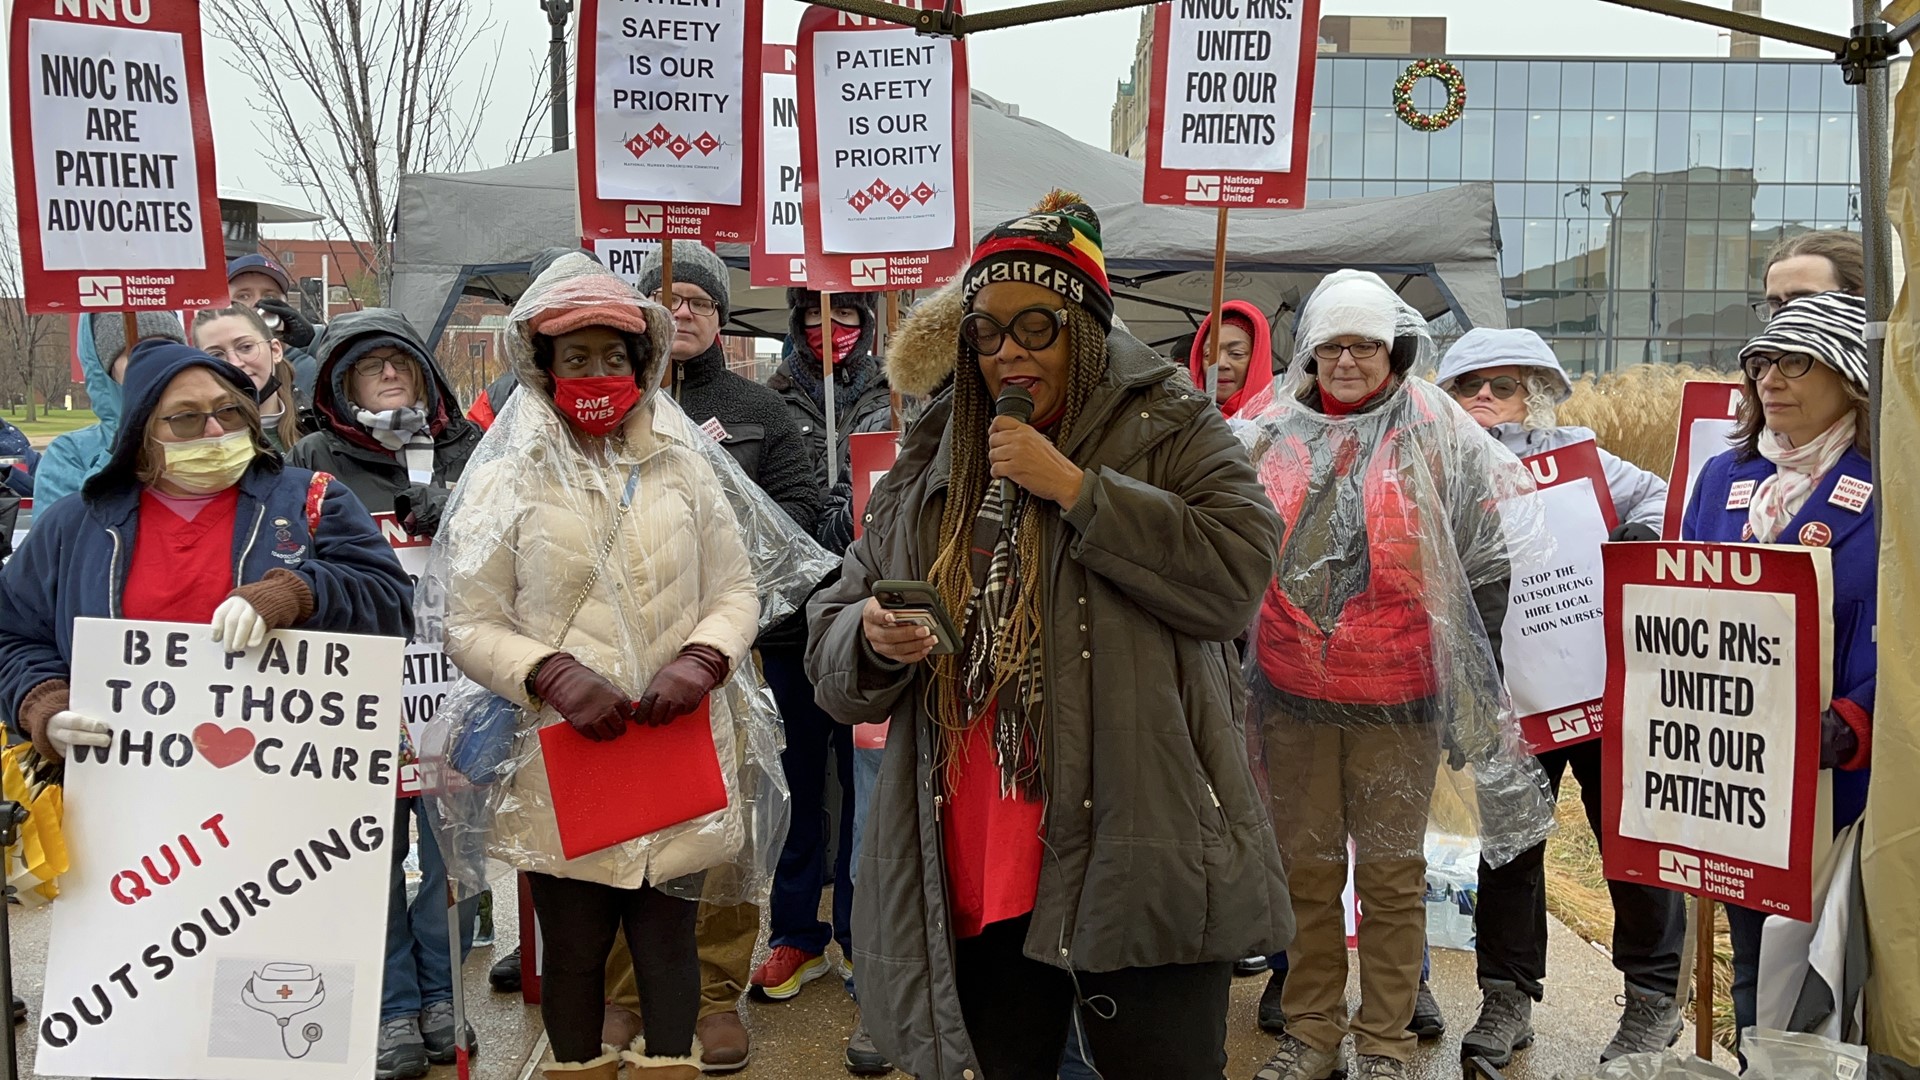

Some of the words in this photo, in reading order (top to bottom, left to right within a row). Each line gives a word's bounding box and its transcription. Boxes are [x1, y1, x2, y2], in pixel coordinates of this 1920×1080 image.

[1181, 0, 1239, 20] NNOC
[1246, 0, 1292, 20] RNs:
[622, 17, 721, 42] SAFETY
[1197, 30, 1272, 61] UNITED
[629, 55, 651, 75] IS
[660, 58, 714, 79] OUR
[837, 46, 935, 69] PATIENT
[41, 54, 116, 100] NNOC
[124, 61, 178, 105] RNs
[841, 79, 932, 102] SAFETY
[1186, 72, 1227, 103] FOR
[1232, 72, 1277, 104] OUR
[613, 90, 730, 113] PRIORITY
[86, 107, 140, 142] ARE
[849, 116, 870, 136] IS
[877, 113, 928, 133] OUR
[1181, 113, 1276, 146] PATIENTS
[835, 144, 942, 168] PRIORITY
[55, 150, 178, 189] PATIENT
[1224, 176, 1263, 185] National
[1222, 194, 1254, 203] United
[1223, 185, 1255, 193] Nurses
[48, 199, 193, 233] ADVOCATES
[667, 205, 710, 216] National
[667, 215, 701, 225] Nurses
[667, 225, 700, 235] United
[889, 254, 929, 266] National
[890, 266, 923, 275] Nurses
[126, 275, 174, 285] National
[127, 286, 166, 295] Nurses
[890, 275, 922, 285] United
[128, 296, 166, 306] United
[575, 396, 610, 409] SAVE
[577, 406, 615, 421] LIVES
[1838, 485, 1867, 499] NURSE
[1841, 478, 1871, 492] UNION
[1521, 571, 1551, 587] STOP
[1553, 565, 1577, 578] THE
[1656, 548, 1762, 584] NNU
[1513, 576, 1593, 605] OUTSOURCING
[1525, 603, 1553, 619] HIRE
[1556, 594, 1592, 611] LOCAL
[1521, 620, 1557, 637] UNION
[1560, 607, 1604, 627] NURSES
[122, 629, 190, 668] BE
[1635, 615, 1709, 658] NNOC
[1719, 620, 1780, 666] RNs:
[1660, 668, 1753, 717] UNITED
[106, 679, 176, 716] TO
[208, 685, 380, 731] THOSE
[73, 728, 194, 768] WHO
[253, 737, 393, 785] CARE
[1649, 719, 1701, 763] FOR
[1709, 727, 1765, 774] OUR
[1645, 771, 1766, 829] PATIENTS
[110, 813, 230, 905] QUIT
[1704, 858, 1754, 879] National
[1704, 870, 1745, 888] Nurses
[1705, 881, 1744, 900] United
[1762, 899, 1790, 911] AFL-CIO
[40, 815, 385, 1048] OUTSOURCING
